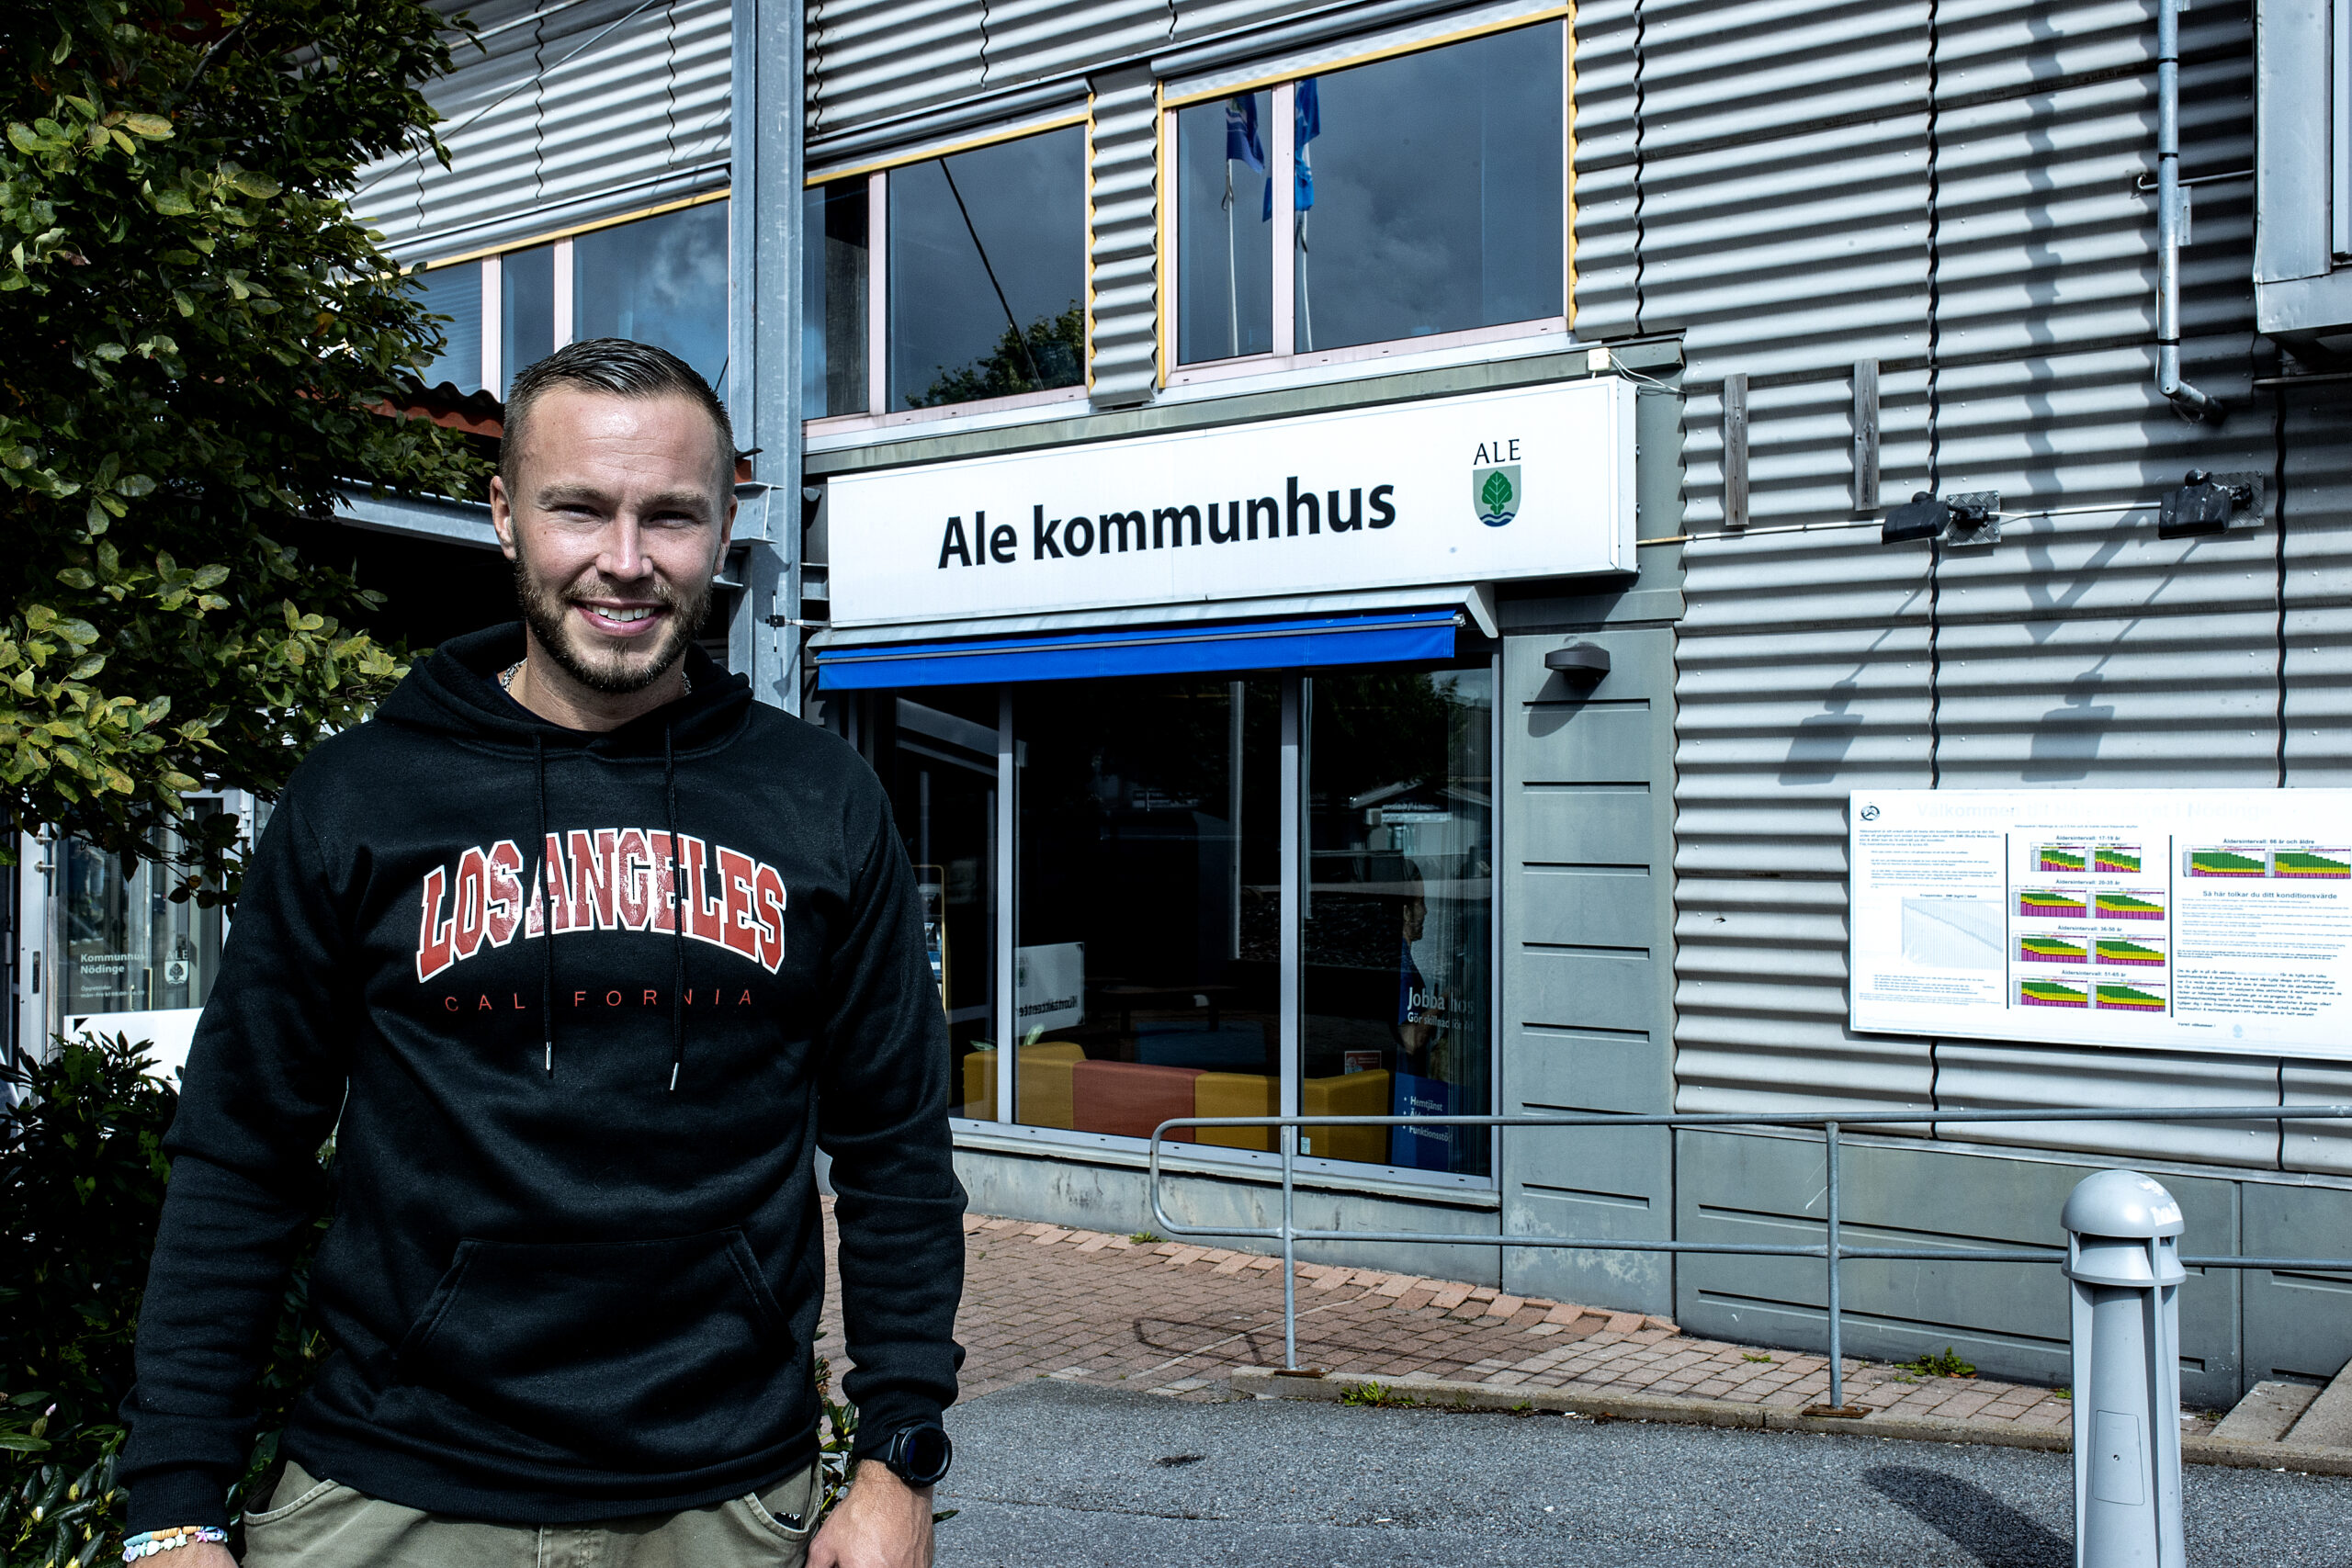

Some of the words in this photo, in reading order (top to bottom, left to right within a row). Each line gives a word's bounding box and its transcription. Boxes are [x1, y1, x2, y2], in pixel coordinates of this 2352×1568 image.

[1474, 438, 1521, 466] ALE
[937, 510, 1018, 570] Ale
[1033, 476, 1396, 560] kommunhus
[416, 840, 525, 984] LOS
[525, 828, 787, 975] ANGELES
[80, 953, 146, 963] Kommunhus
[166, 950, 189, 959] ALE
[80, 964, 125, 975] Nödinge
[445, 989, 752, 1011] CALFORNIA
[1407, 987, 1446, 1011] Jobba
[1407, 1011, 1423, 1024] Gör
[1409, 1095, 1443, 1111] Hemtjänst
